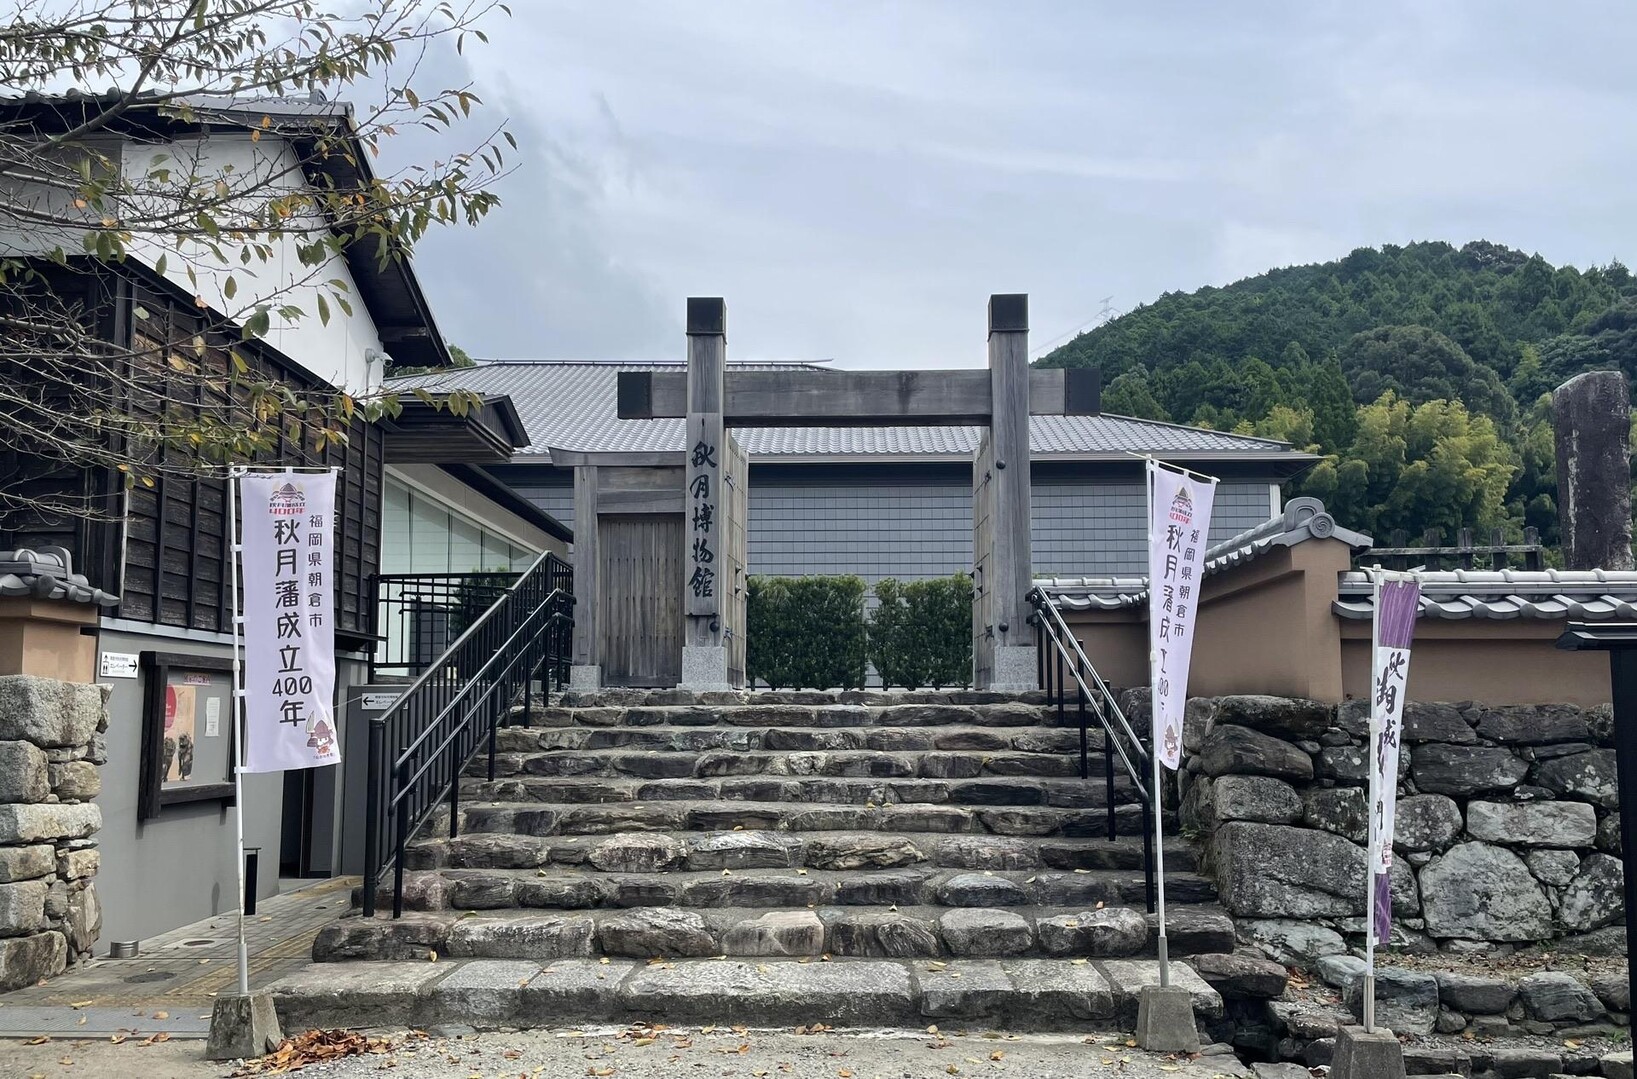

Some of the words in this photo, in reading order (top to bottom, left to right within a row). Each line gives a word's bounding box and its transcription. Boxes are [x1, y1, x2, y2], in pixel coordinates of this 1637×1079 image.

[308, 514, 323, 627] 福岡県朝倉市
[688, 439, 718, 599] 秋月博物館
[1174, 529, 1200, 637] 福岡県朝倉市
[272, 518, 313, 727] 秋月藩成立400年
